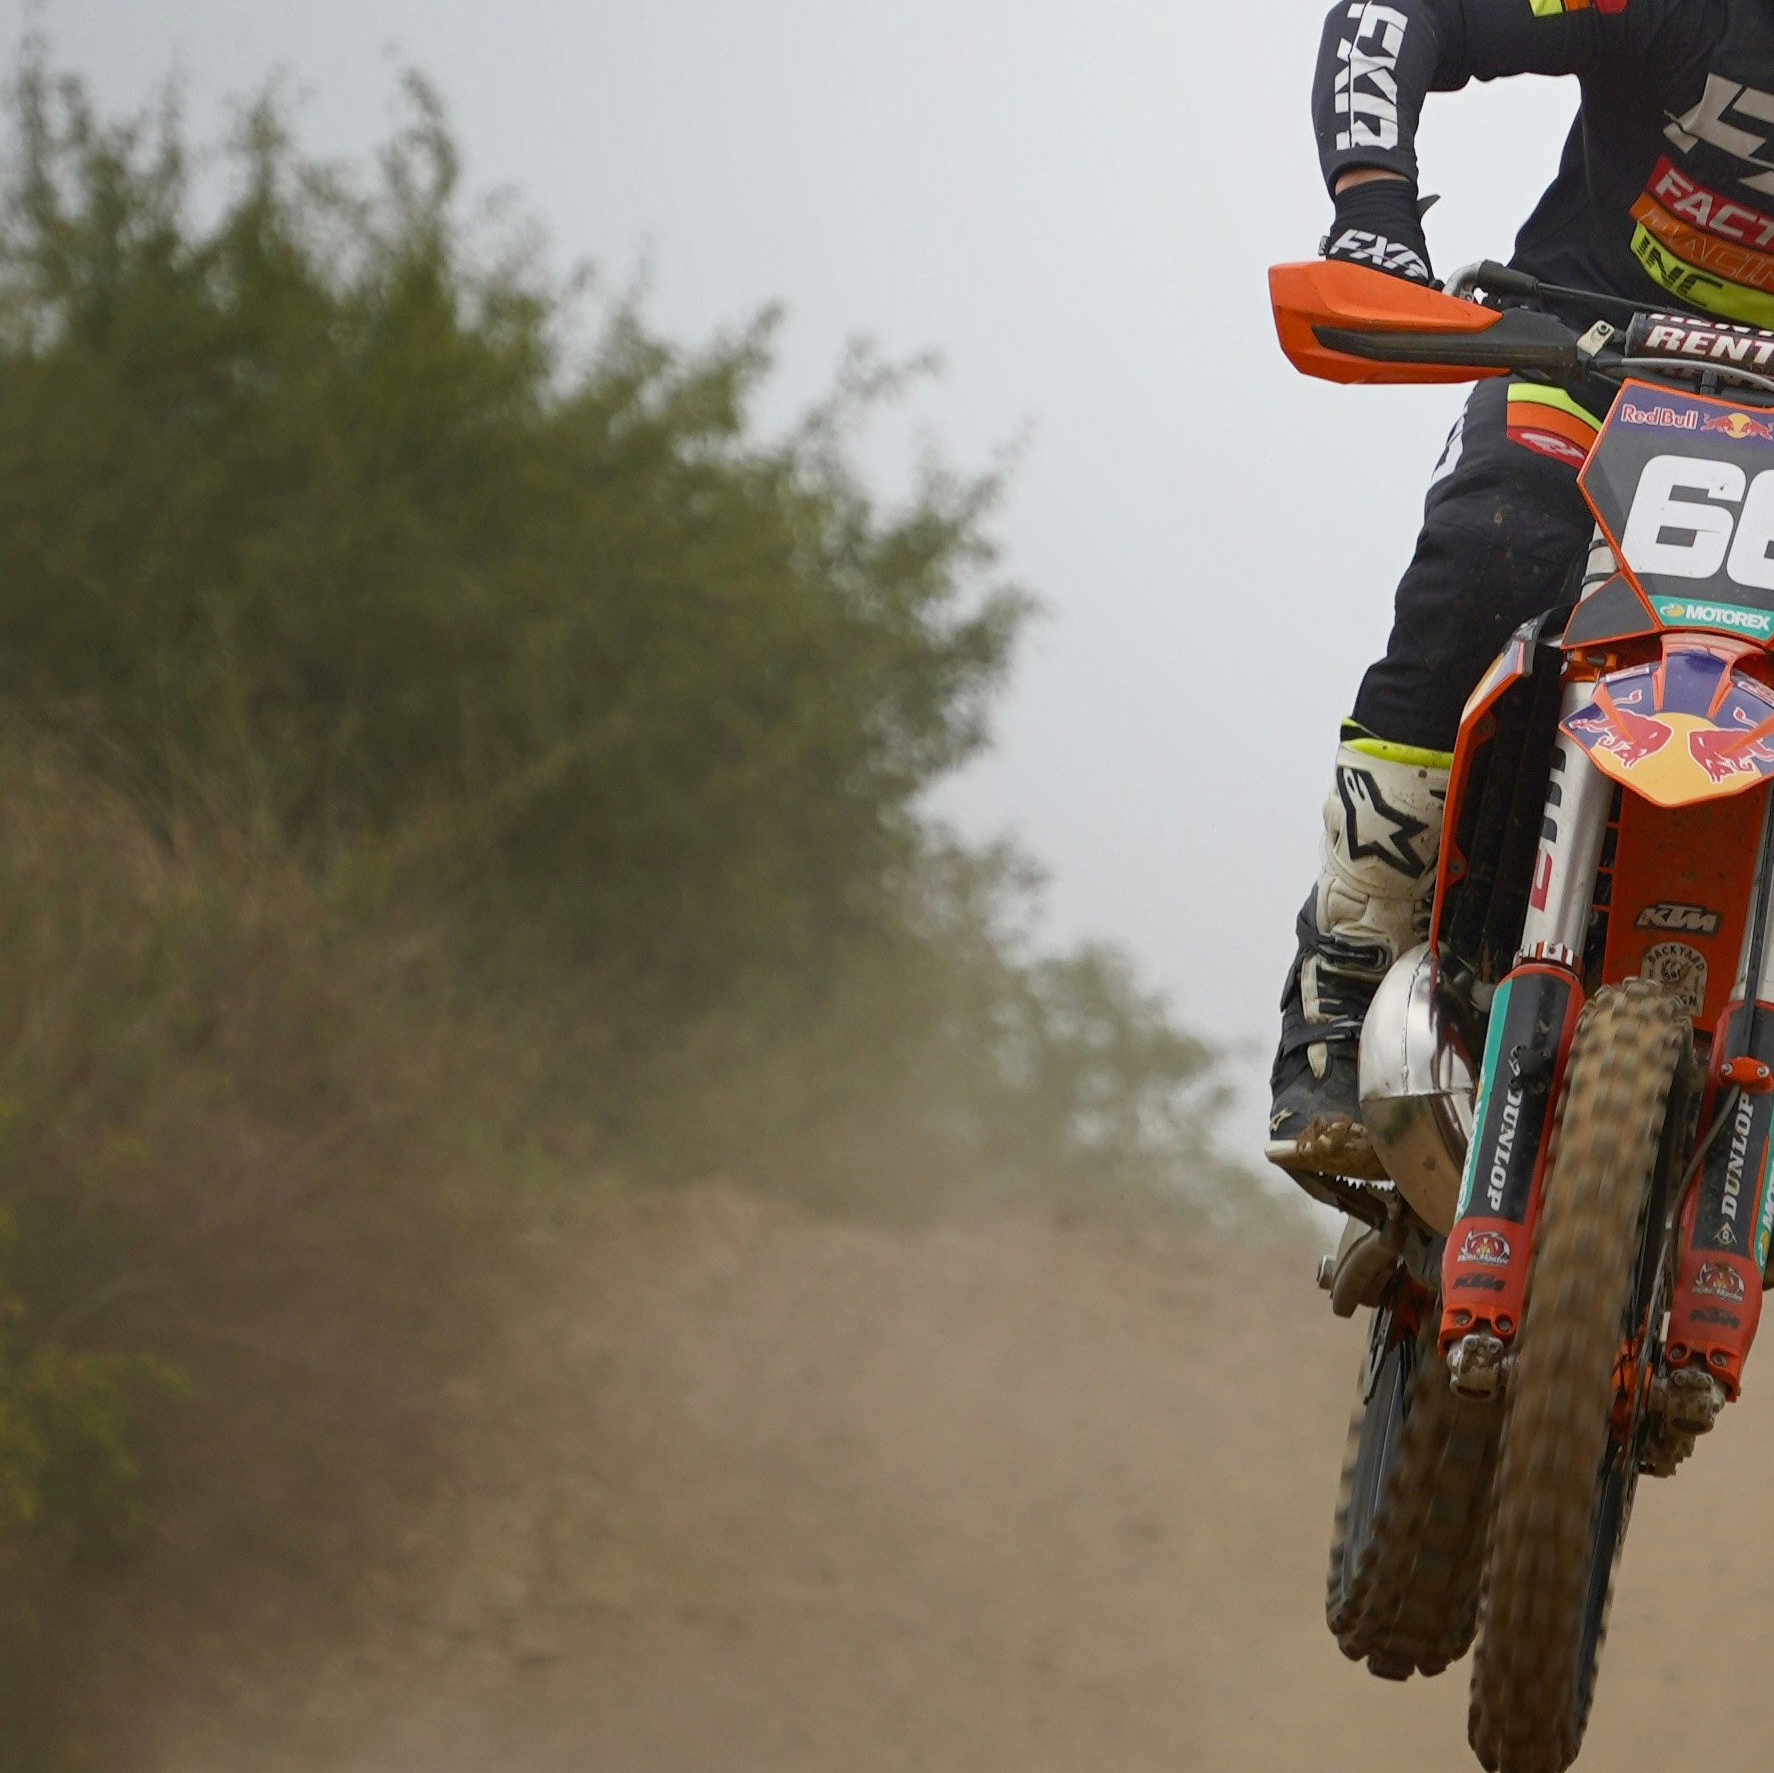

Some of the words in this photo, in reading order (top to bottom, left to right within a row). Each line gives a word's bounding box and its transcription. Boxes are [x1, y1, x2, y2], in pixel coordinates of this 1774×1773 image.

[1334, 0, 1408, 150] FXR
[1329, 229, 1429, 281] FXR
[1621, 404, 1659, 426] Red
[1660, 408, 1699, 430] Bull
[1685, 603, 1772, 632] MOTOREX
[1636, 904, 1718, 932] KTM
[1646, 945, 1705, 971] BACKYARD
[1487, 1087, 1523, 1212] DUNLOP
[1721, 1092, 1756, 1222] DUNLOP
